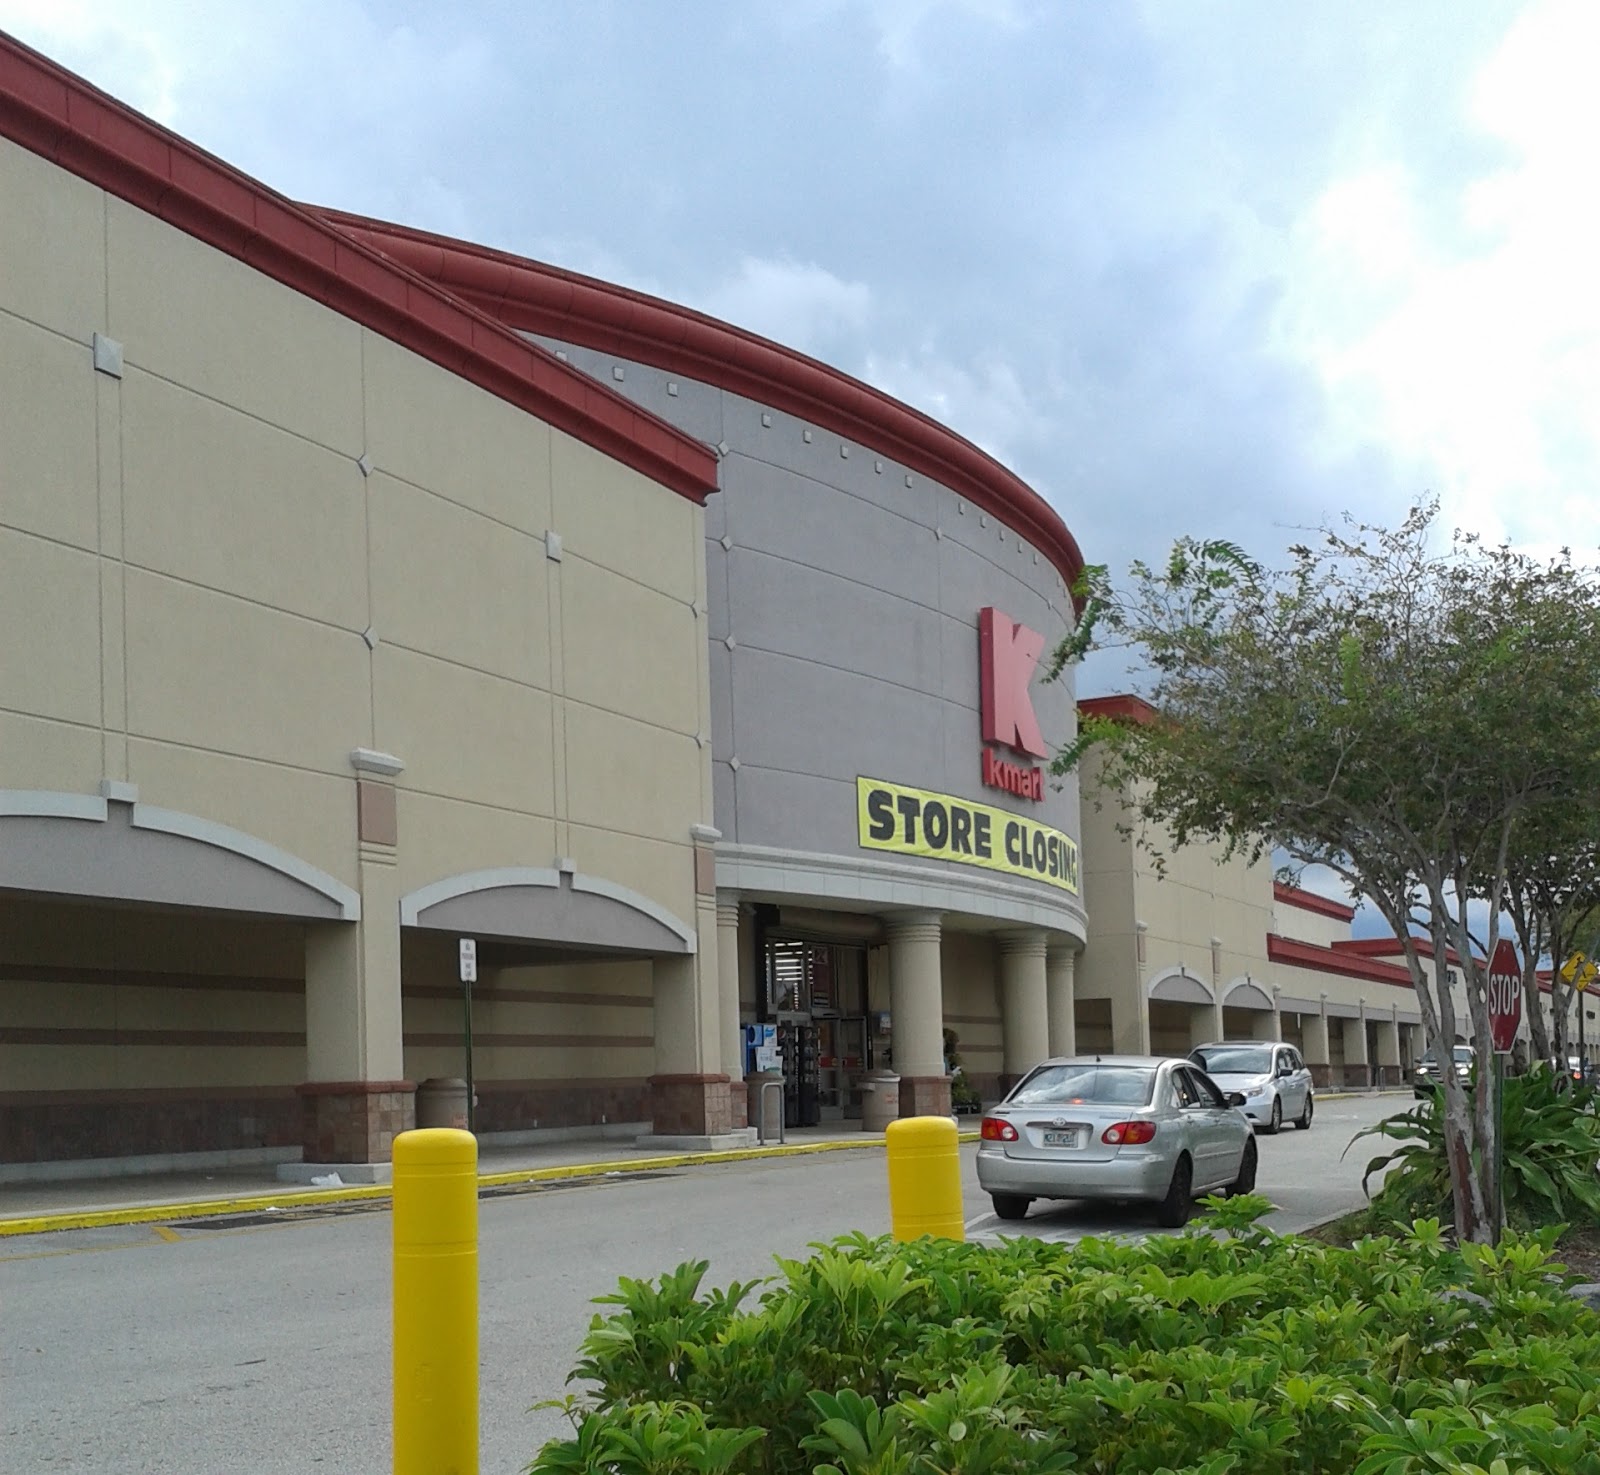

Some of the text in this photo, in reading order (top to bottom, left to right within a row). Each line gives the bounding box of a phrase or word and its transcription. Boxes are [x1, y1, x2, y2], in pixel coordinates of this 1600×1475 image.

[980, 606, 1048, 760] K
[867, 789, 992, 859] STORE
[1489, 973, 1520, 1016] STOP
